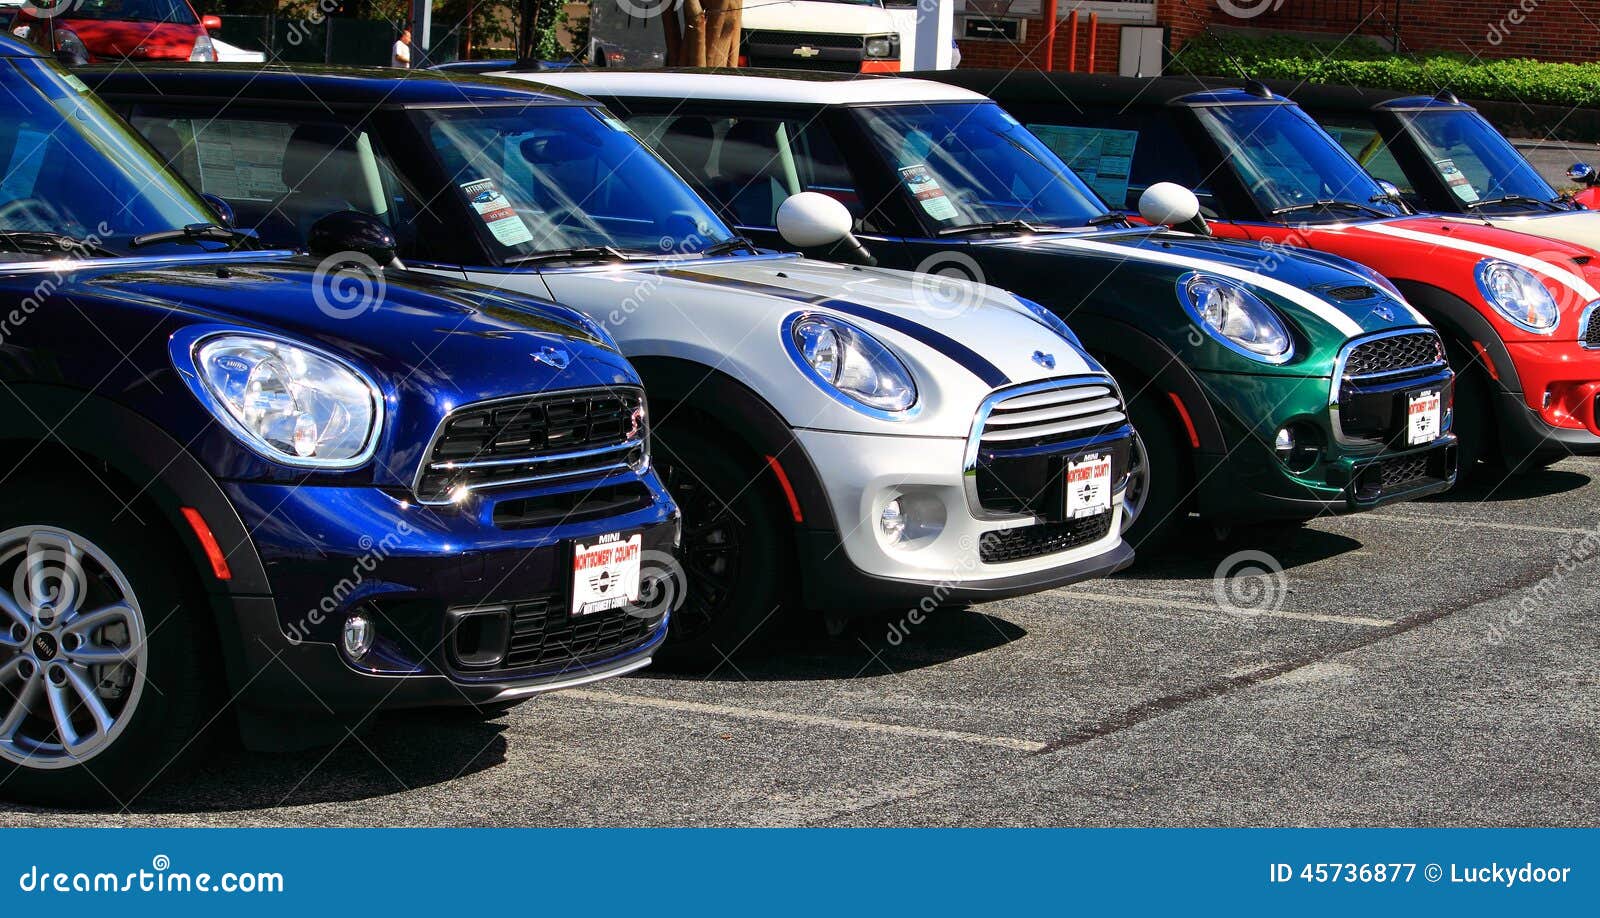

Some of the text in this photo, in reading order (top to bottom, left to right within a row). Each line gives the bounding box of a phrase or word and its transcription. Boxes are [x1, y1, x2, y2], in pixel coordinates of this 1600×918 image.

[599, 533, 620, 544] MINI
[574, 544, 638, 571] MONTGOMERY COUNTY
[36, 637, 54, 657] MINI
